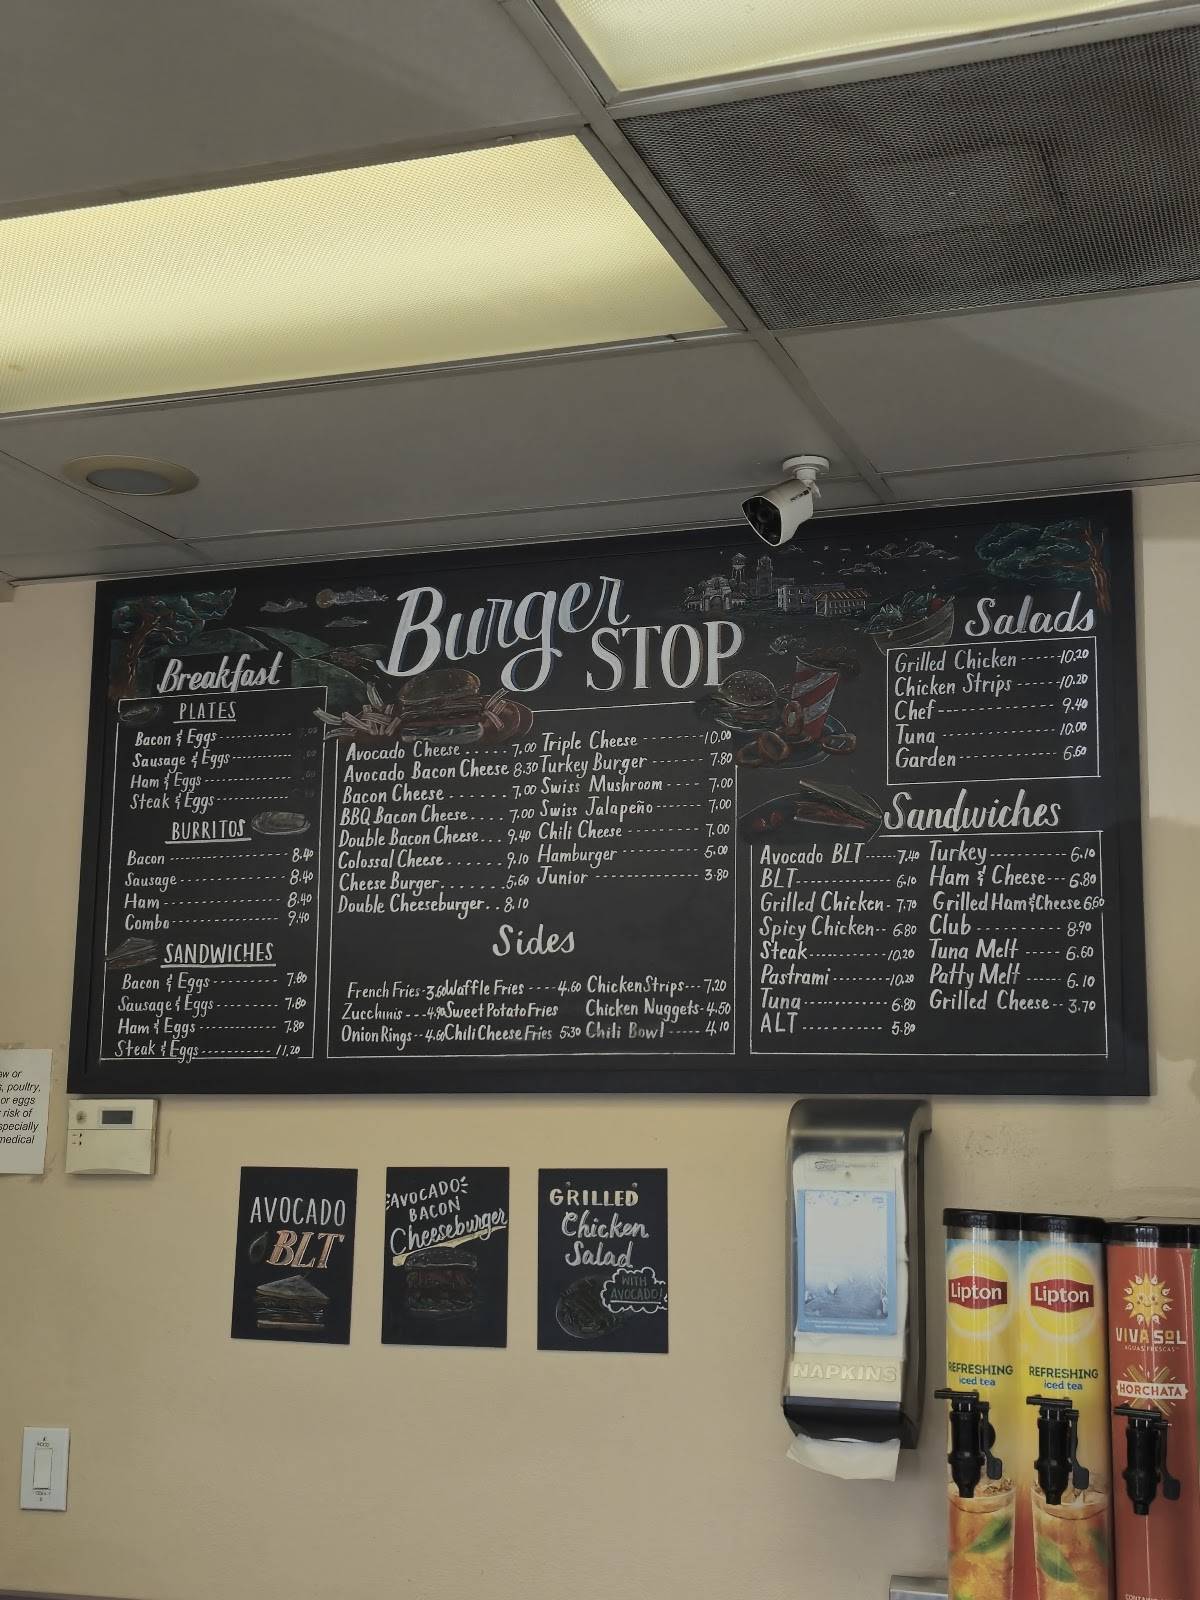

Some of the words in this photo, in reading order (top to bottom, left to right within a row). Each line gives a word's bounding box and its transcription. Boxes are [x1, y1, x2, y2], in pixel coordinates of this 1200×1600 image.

[965, 590, 1094, 637] Salads
[376, 576, 630, 692] Burger
[587, 621, 743, 691] STOP
[895, 650, 947, 673] Grilled
[954, 648, 1016, 669] Chicken
[157, 651, 283, 693] Breakfast
[894, 675, 956, 697] Chicken
[963, 672, 1012, 697] Strips
[179, 702, 236, 719] PLATES
[894, 700, 936, 721] Chef
[135, 732, 171, 746] Bacon
[187, 729, 217, 748] Eggs
[542, 731, 582, 756] Triple
[590, 730, 637, 750] Cheese
[896, 723, 935, 744] Tuna
[132, 753, 186, 773] Sausage
[202, 749, 230, 769] Eggs
[346, 741, 405, 761] Avocado
[413, 741, 461, 758] Cheese
[895, 746, 956, 768] Garden
[344, 763, 405, 782] Avocado
[411, 761, 456, 779] Bacon
[460, 758, 509, 778] Cheese
[539, 754, 588, 779] Turkey
[593, 752, 648, 775] Burger
[710, 752, 733, 766] 7.80
[130, 774, 159, 789] Ham
[174, 772, 202, 792] Eggs
[541, 777, 580, 794] Swiss
[589, 775, 663, 792] Mushroom
[708, 777, 733, 793] 7.00
[130, 794, 169, 810] Steak
[184, 791, 214, 814] Eggs
[343, 786, 387, 804] Bacon
[392, 783, 445, 801] Cheese
[512, 785, 537, 800] 7.00
[340, 807, 371, 825] BBQ
[373, 806, 417, 824] Bacon
[421, 804, 468, 821] Cheese
[509, 809, 535, 823] 7.00
[540, 799, 577, 817] Swiss
[585, 796, 653, 822] Jalapeño
[708, 799, 732, 813] 7.00
[884, 789, 1062, 832] Sandwiches
[172, 818, 245, 840] BURRITOS
[339, 828, 385, 848] Double
[388, 827, 430, 846] Bacon
[434, 825, 479, 844] Cheese
[508, 829, 531, 845] 9.40
[538, 821, 572, 840] Chili
[578, 819, 622, 839] Cheese
[706, 824, 730, 837] 7.00
[127, 850, 165, 866] Bacon
[338, 849, 395, 869] Colossal
[397, 849, 443, 868] Cheese
[507, 852, 529, 869] 9.10
[537, 843, 618, 869] Hamburger
[760, 843, 823, 865] Avocado
[832, 843, 865, 864] BLT
[929, 839, 987, 865] Turkey
[124, 872, 177, 892] Sausage
[339, 872, 387, 891] Cheese
[390, 871, 440, 896] Burger
[537, 866, 588, 885] Junior
[760, 868, 799, 889] BLT
[929, 864, 970, 887] Ham
[991, 863, 1046, 885] Cheese
[124, 893, 160, 909] Ham
[338, 895, 385, 914] Double
[390, 892, 485, 920] Cheeseburger
[760, 891, 815, 912] Grilled
[821, 890, 884, 912] Chicken
[125, 913, 170, 931] Combo
[760, 915, 806, 942] Spicy
[812, 914, 874, 937] Chicken
[929, 913, 971, 935] Club
[492, 923, 575, 957] Sides
[760, 941, 808, 960] Steak
[929, 938, 969, 959] Tuna
[976, 938, 1019, 959] Melt
[164, 942, 274, 964] SANDWICHES
[122, 973, 160, 990] Bacon
[178, 972, 210, 993] Eggs
[761, 963, 831, 985] Pastrami
[929, 962, 974, 989] Patty
[979, 962, 1020, 985] Melt
[348, 981, 389, 999] French
[392, 981, 420, 998] Fries
[445, 979, 490, 996] Waffle
[494, 979, 525, 996] Fries
[558, 980, 582, 996] 4.60
[760, 987, 801, 1009] Tuna
[118, 996, 172, 1017] Sausage
[185, 994, 214, 1019] Eggs
[285, 997, 306, 1011] 7.80
[445, 1001, 484, 1018] Sweet
[487, 1002, 526, 1018] Potato
[528, 1001, 559, 1018] Fries
[929, 988, 988, 1011] Grilled
[997, 988, 1050, 1010] Cheese
[342, 1002, 402, 1020] Zucchinis
[586, 998, 638, 1017] Chicken
[644, 998, 700, 1023] Nuggets
[707, 1001, 731, 1016] 4.50
[118, 1018, 150, 1035] Ham
[164, 1017, 196, 1039] Eggs
[284, 1020, 304, 1033] 7.80
[444, 1023, 475, 1041] Chili
[478, 1024, 523, 1041] Cheese
[525, 1024, 552, 1041] Fries
[586, 1021, 621, 1039] Chili
[629, 1021, 665, 1039] Bowl
[760, 1012, 798, 1033] ALT
[342, 1024, 378, 1043] Onion
[381, 1026, 412, 1051] Rings
[115, 1039, 156, 1057] Steak
[170, 1039, 199, 1063] Eggs
[7, 1082, 40, 1093] poultry,
[1, 1096, 10, 1104] or
[12, 1096, 36, 1106] eggs
[3, 1109, 20, 1118] risk
[23, 1109, 33, 1117] of
[0, 1122, 39, 1133] specially
[390, 1178, 460, 1209] AVOCADO
[550, 1189, 638, 1206] GRILLED
[249, 1196, 347, 1226] AVOCADO
[409, 1196, 460, 1222] BACON
[390, 1207, 507, 1255] Cheeseburger
[561, 1210, 649, 1238] Chicken
[266, 1229, 345, 1269] BLT
[565, 1241, 633, 1268] Salad
[622, 1275, 647, 1286] WITH
[951, 1282, 1002, 1302] Lipton
[1035, 1285, 1089, 1305] Lipton
[1116, 1327, 1150, 1342] VIVA
[793, 1362, 896, 1382] NAPKINS
[948, 1362, 1013, 1375] REFRESHING
[1029, 1366, 1098, 1379] REFRESHING
[959, 1378, 977, 1386] iced
[1044, 1381, 1064, 1389] iced
[1067, 1382, 1083, 1390] tea
[1119, 1382, 1183, 1398] HORCHATA
